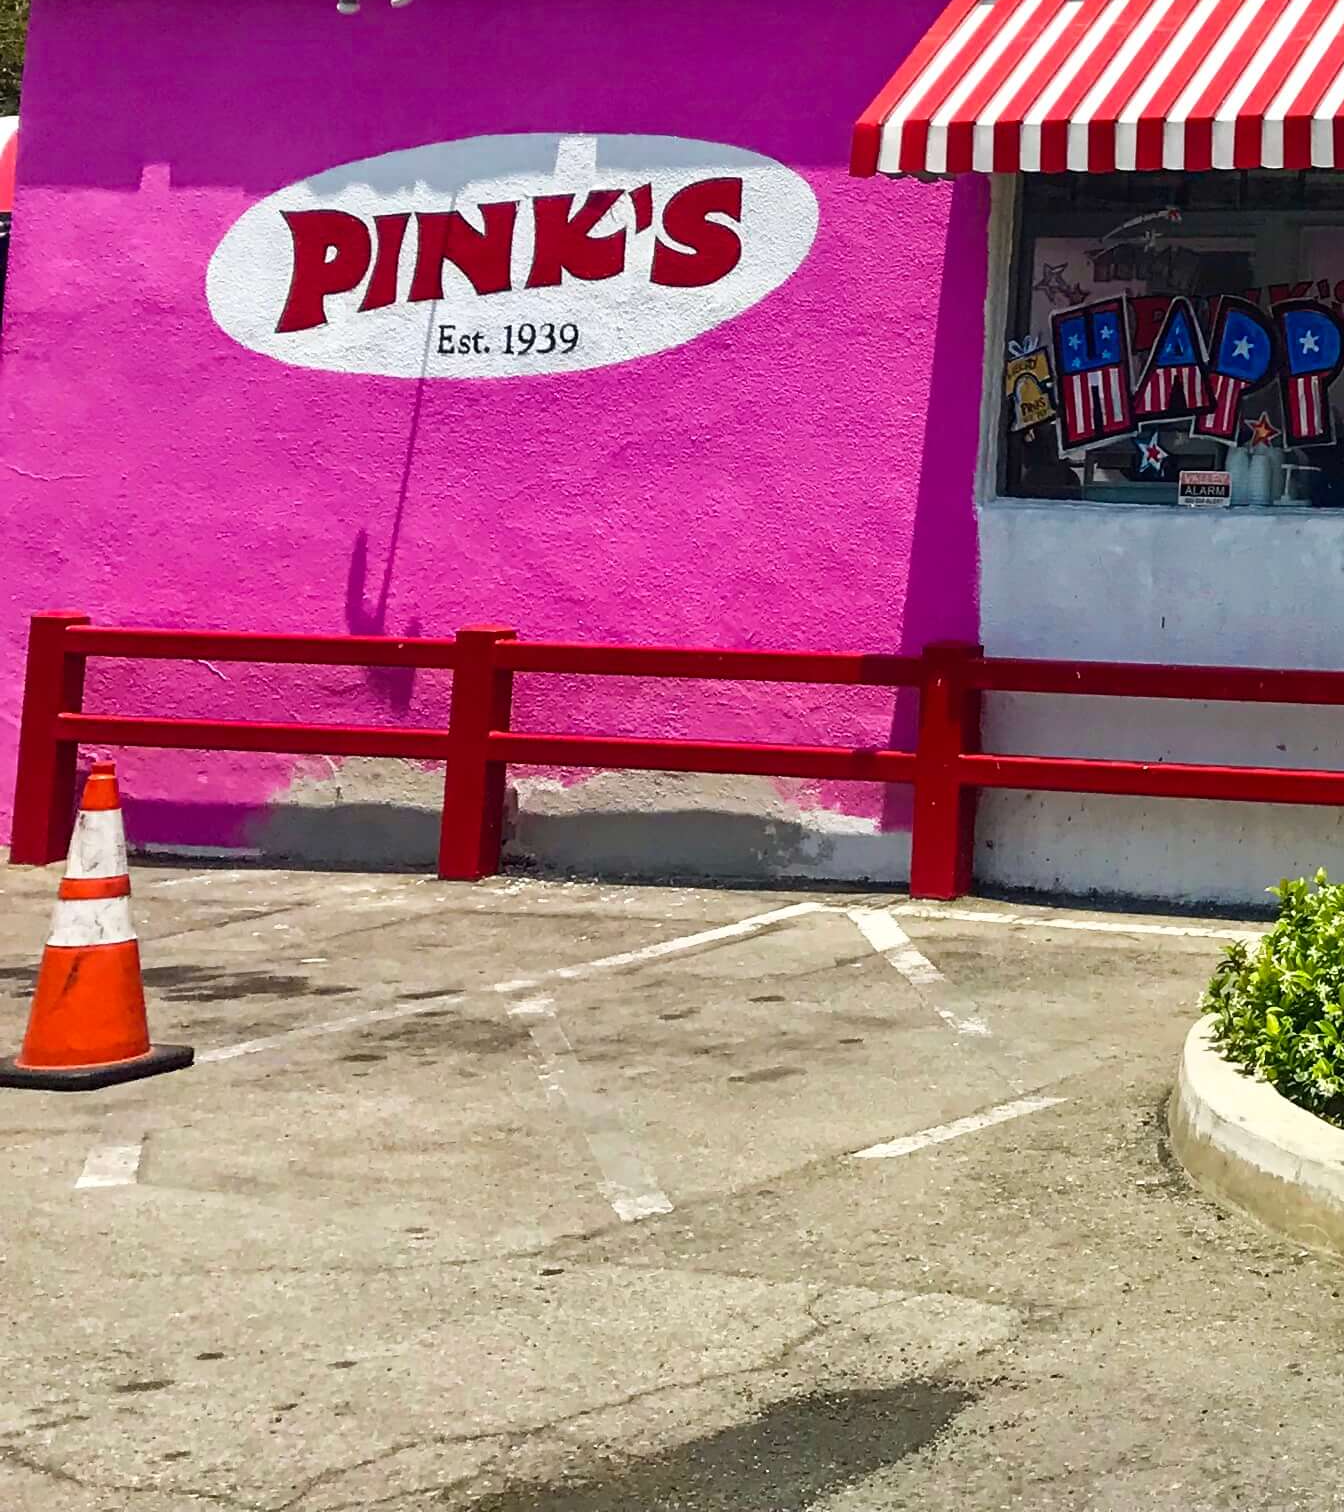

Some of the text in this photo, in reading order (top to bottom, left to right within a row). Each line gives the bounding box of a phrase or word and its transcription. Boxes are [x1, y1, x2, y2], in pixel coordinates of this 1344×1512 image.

[275, 177, 744, 334] PINK'S
[437, 322, 580, 355] Est. 1939
[1184, 486, 1225, 496] ALARM
